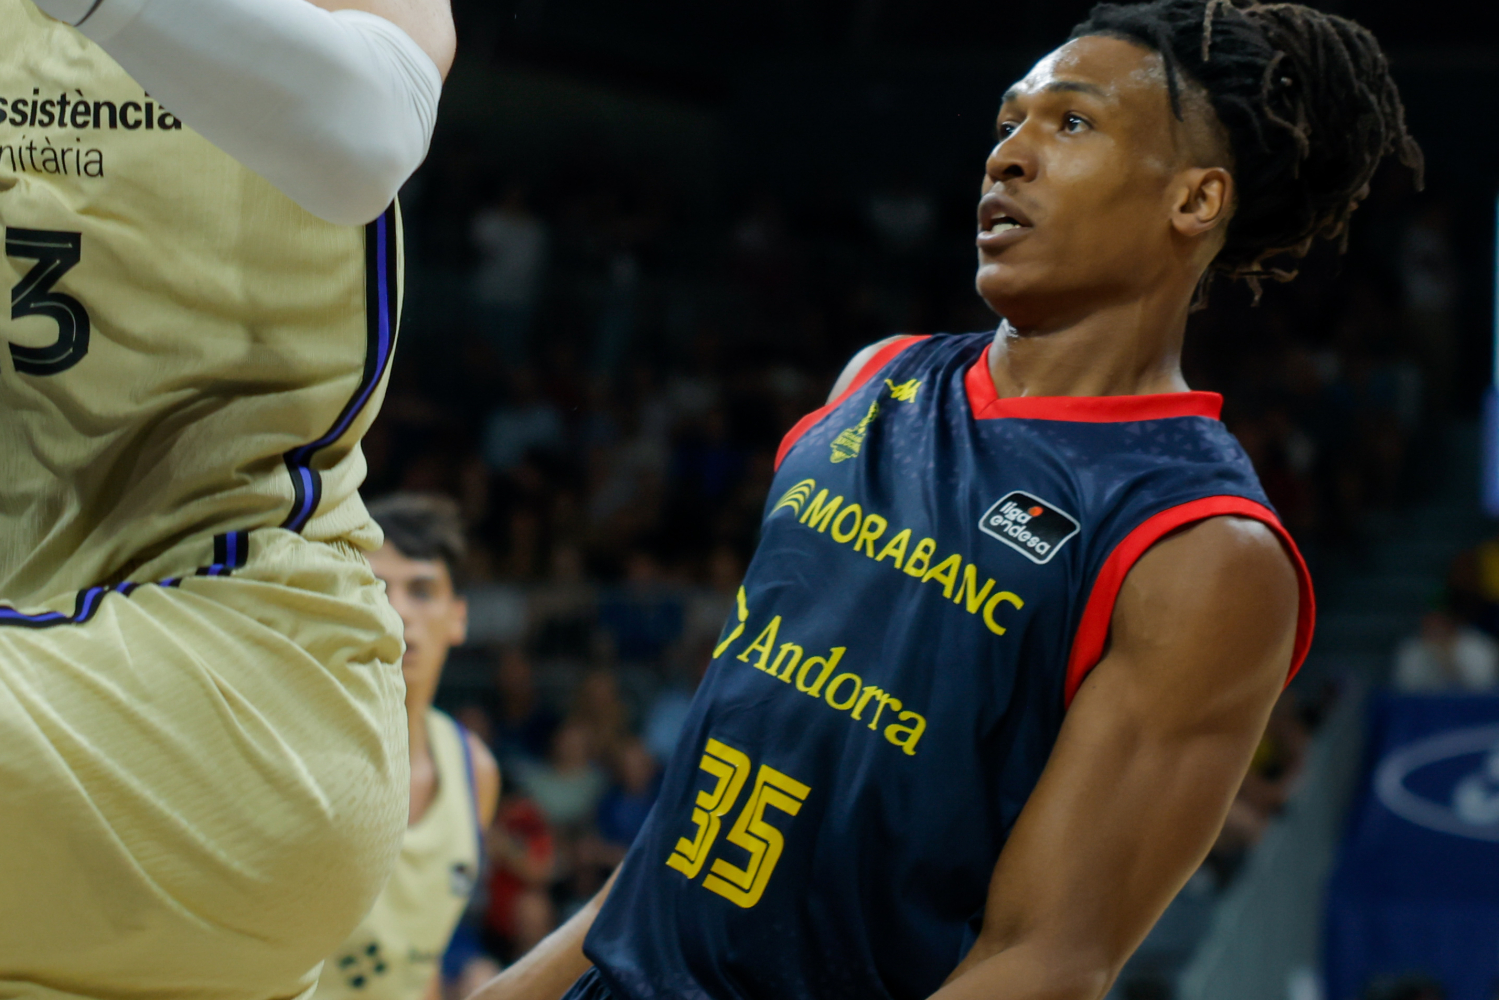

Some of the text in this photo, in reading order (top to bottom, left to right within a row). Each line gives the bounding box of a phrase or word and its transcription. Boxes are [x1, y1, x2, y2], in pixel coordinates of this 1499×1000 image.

[799, 488, 1025, 636] MORABANC
[989, 514, 1051, 555] endesa
[999, 501, 1033, 524] liga
[736, 615, 927, 756] Andorra
[665, 737, 812, 909] 35
